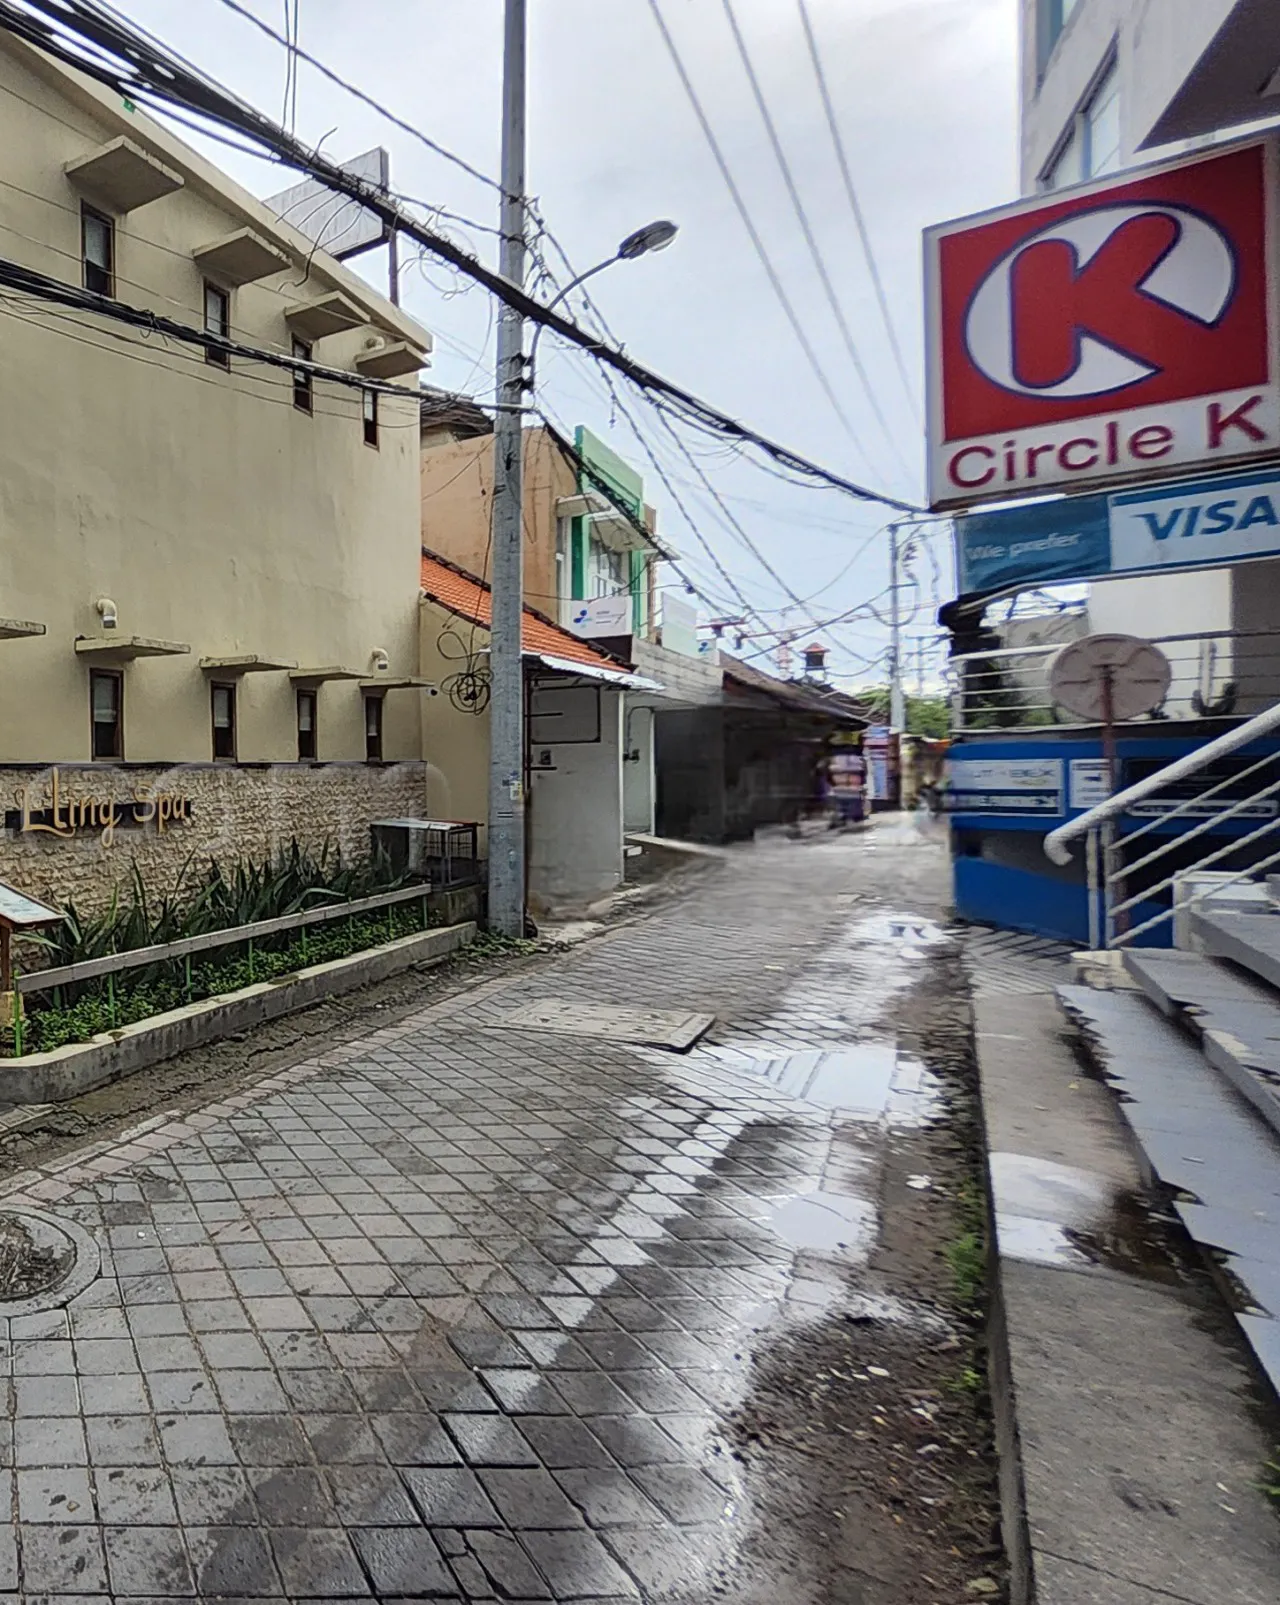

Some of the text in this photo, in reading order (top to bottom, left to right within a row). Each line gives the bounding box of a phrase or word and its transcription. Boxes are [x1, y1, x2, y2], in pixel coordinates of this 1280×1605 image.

[947, 395, 1268, 488] Circle K
[1132, 495, 1280, 541] VISA
[133, 780, 188, 835] Spa
